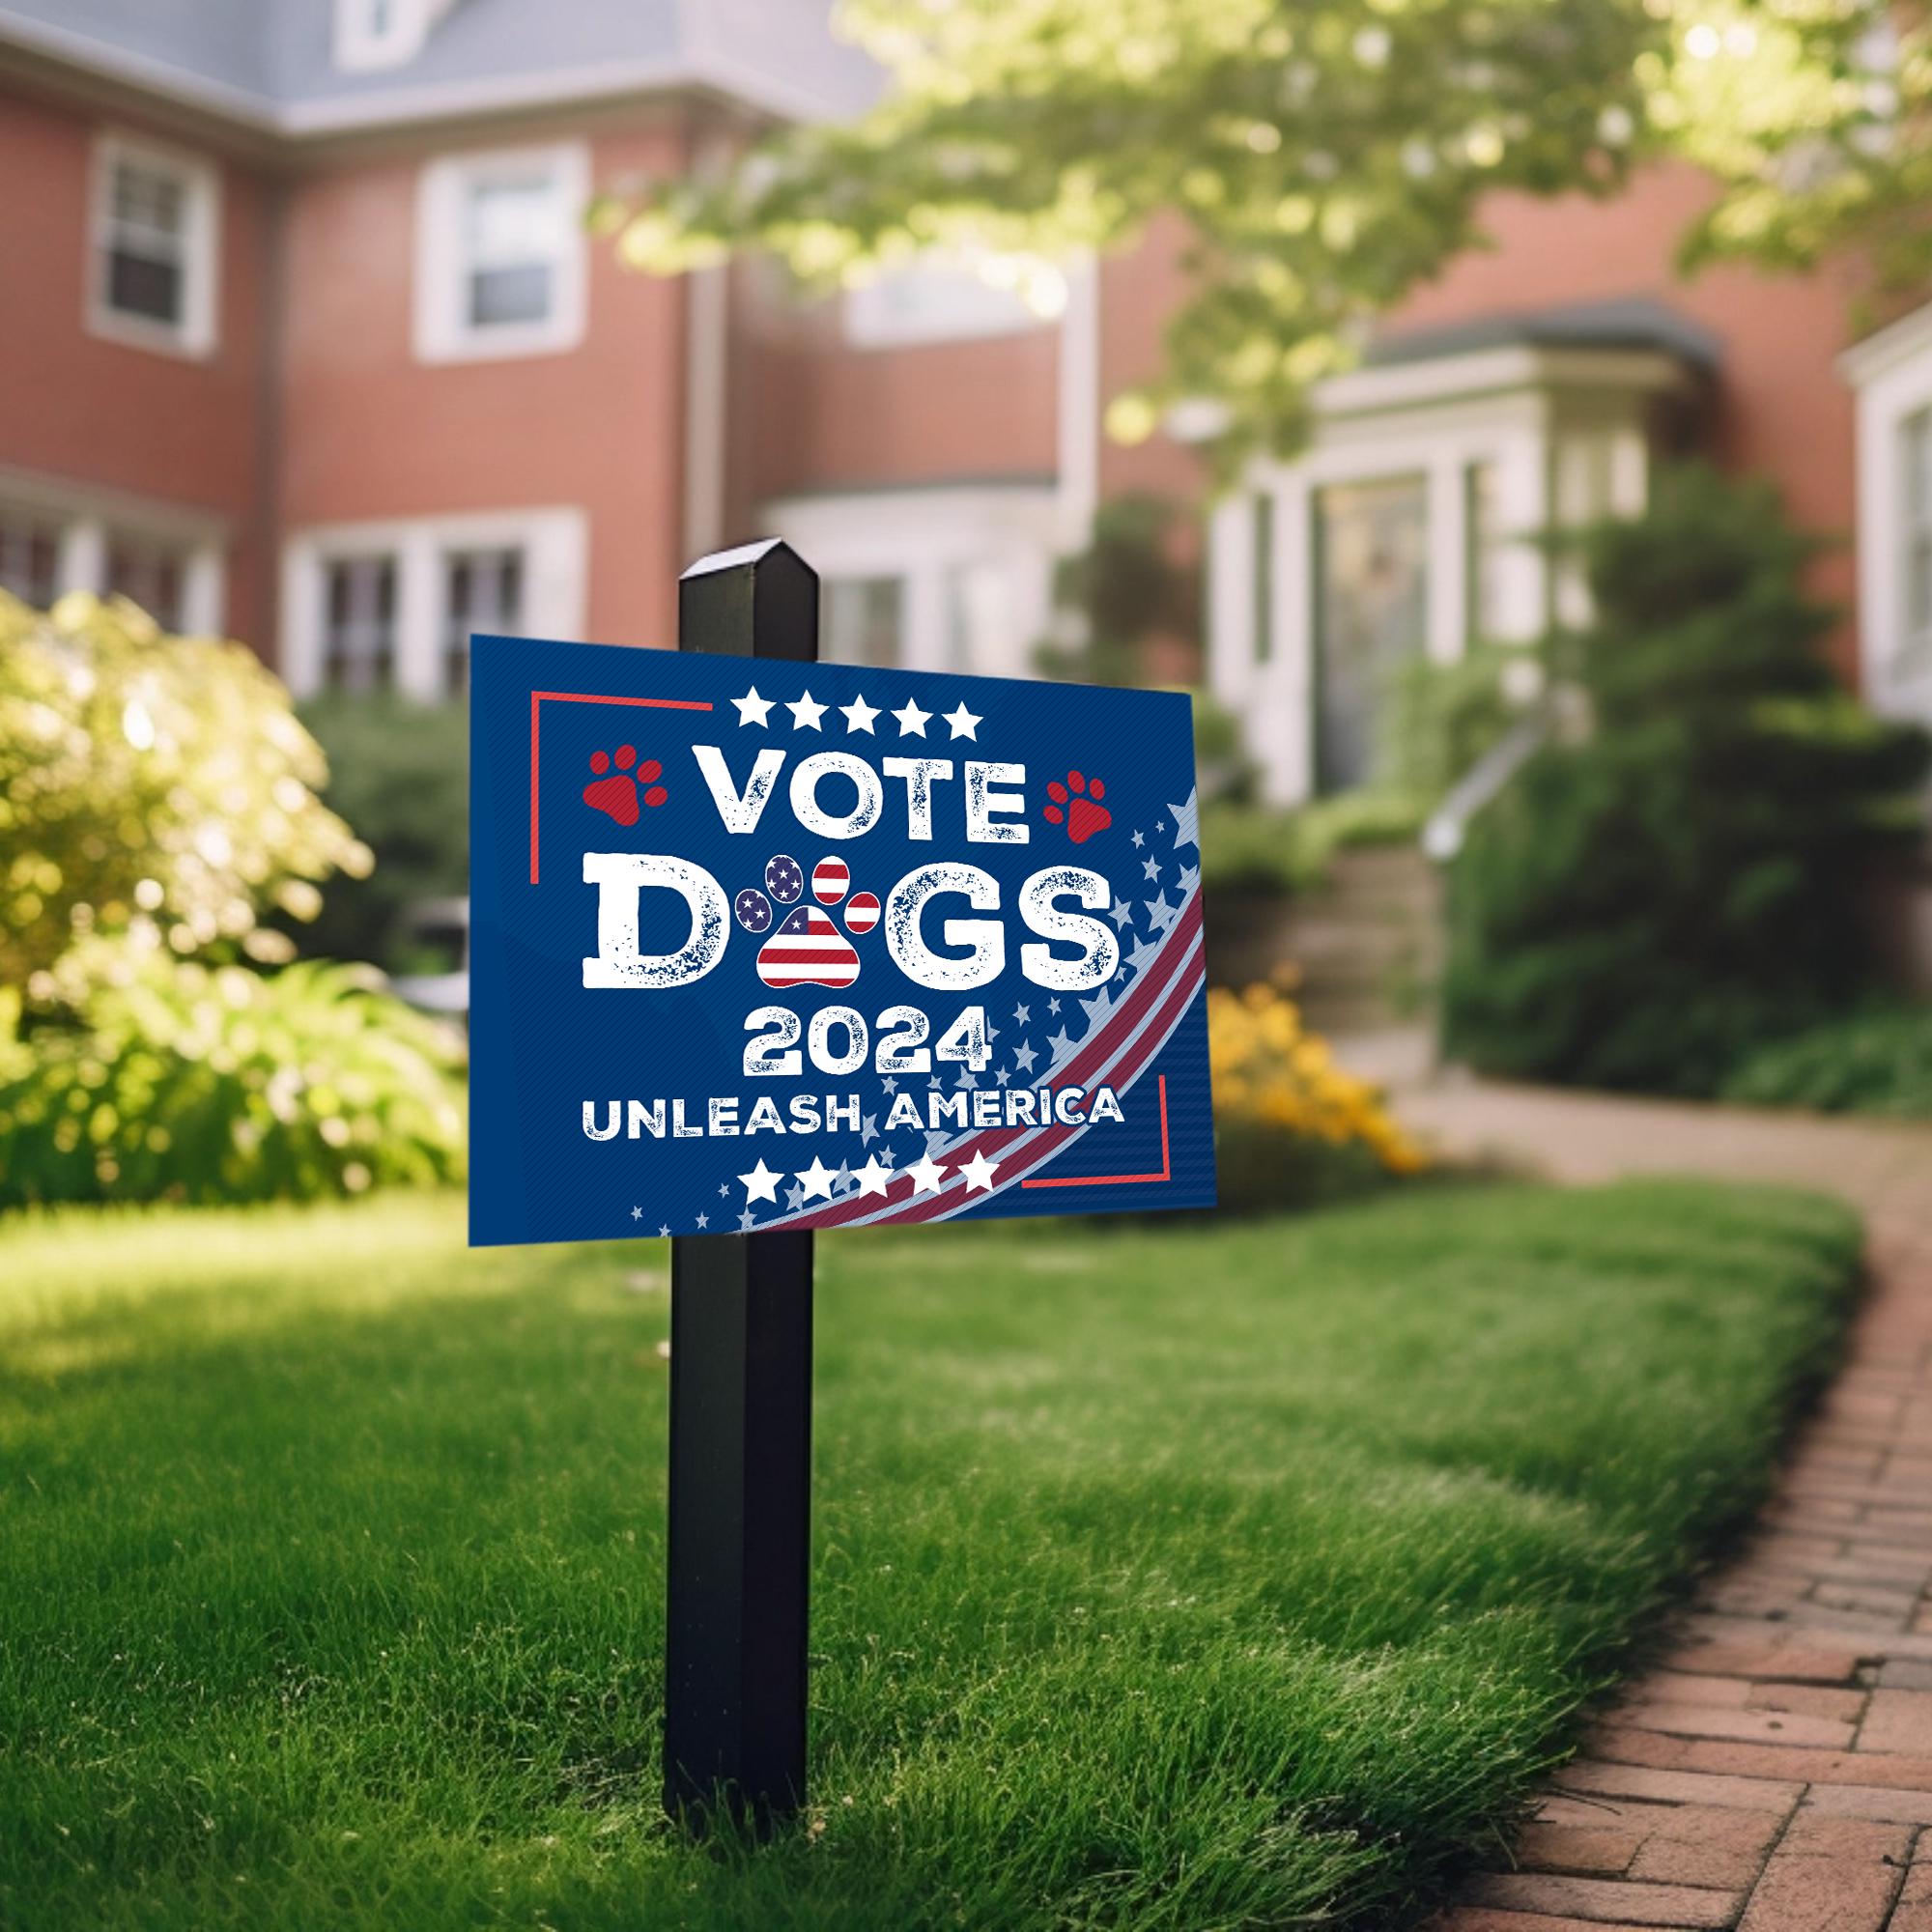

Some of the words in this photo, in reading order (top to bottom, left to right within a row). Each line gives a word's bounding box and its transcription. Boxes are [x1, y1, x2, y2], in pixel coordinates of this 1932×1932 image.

[692, 744, 1030, 844] VOTE
[582, 852, 1120, 991] DGS
[743, 1005, 992, 1076] 2024
[582, 1094, 861, 1142] UNLEASH
[885, 1087, 1125, 1130] AMERICA
